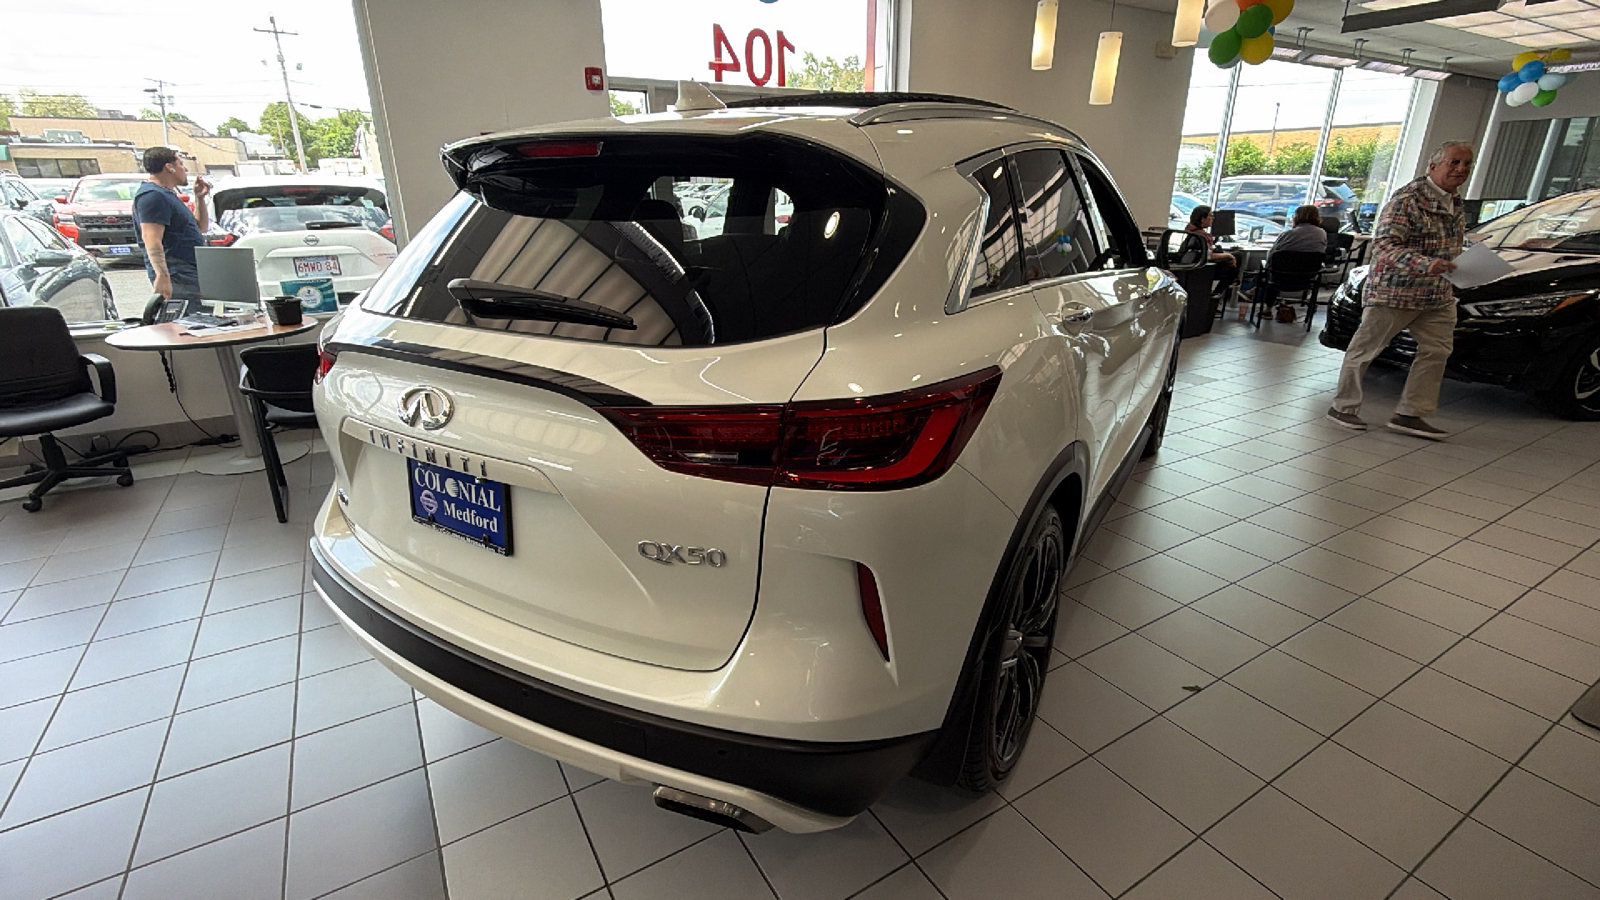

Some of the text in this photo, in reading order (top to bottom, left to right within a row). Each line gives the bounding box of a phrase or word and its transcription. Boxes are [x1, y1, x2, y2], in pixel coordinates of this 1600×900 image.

[368, 428, 487, 477] INFINITI
[414, 466, 501, 512] COLONIAL
[443, 499, 498, 533] Medford
[638, 540, 727, 568] QX50
